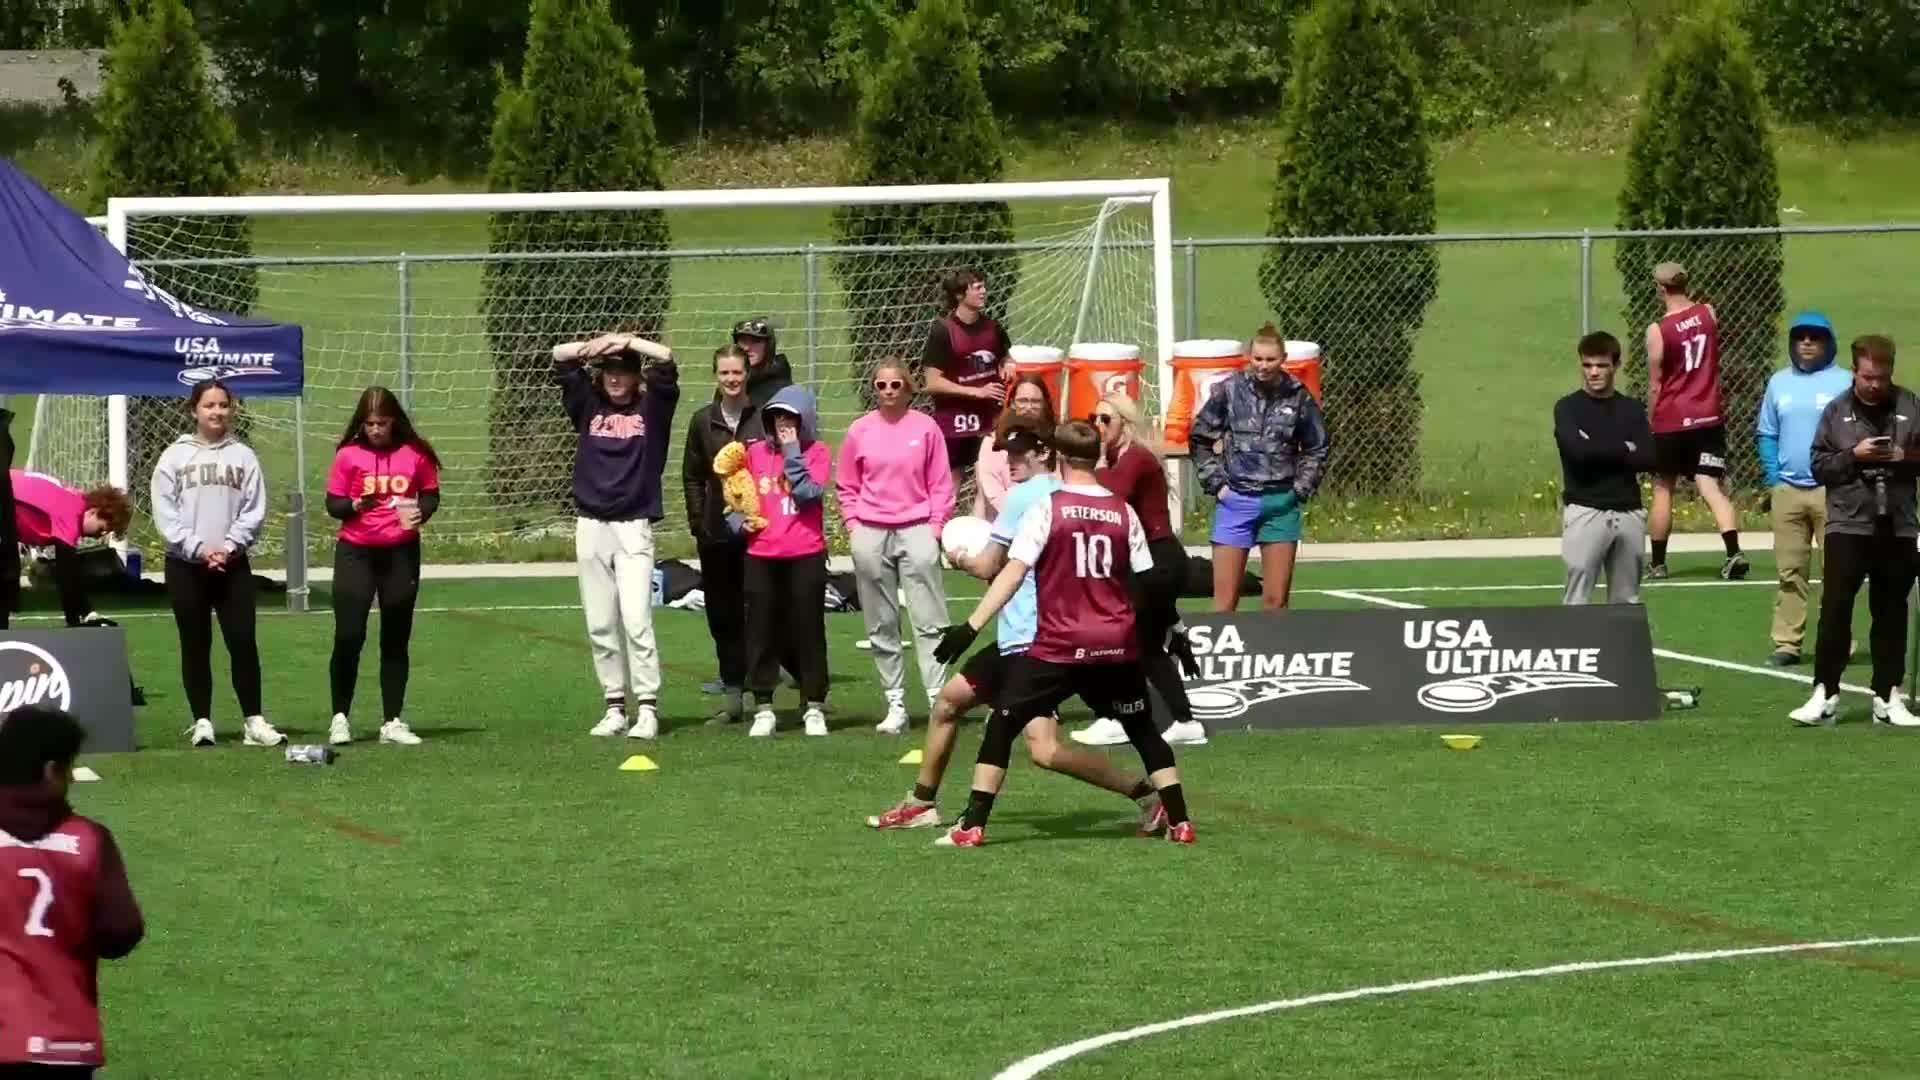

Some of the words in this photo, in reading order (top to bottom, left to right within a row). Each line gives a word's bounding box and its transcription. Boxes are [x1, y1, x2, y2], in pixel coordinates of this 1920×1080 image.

[0, 303, 140, 328] IMATE
[175, 337, 219, 353] USA
[1682, 334, 1706, 372] 17
[185, 353, 274, 366] ULTIMATE
[954, 414, 980, 432] 99
[363, 475, 409, 495] STO
[1061, 505, 1122, 526] PETERSON
[1072, 532, 1112, 578] 10
[1184, 625, 1244, 655] SA
[1403, 619, 1492, 649] USA
[1426, 648, 1600, 674] ULTIMATE
[18, 868, 54, 936] 2
